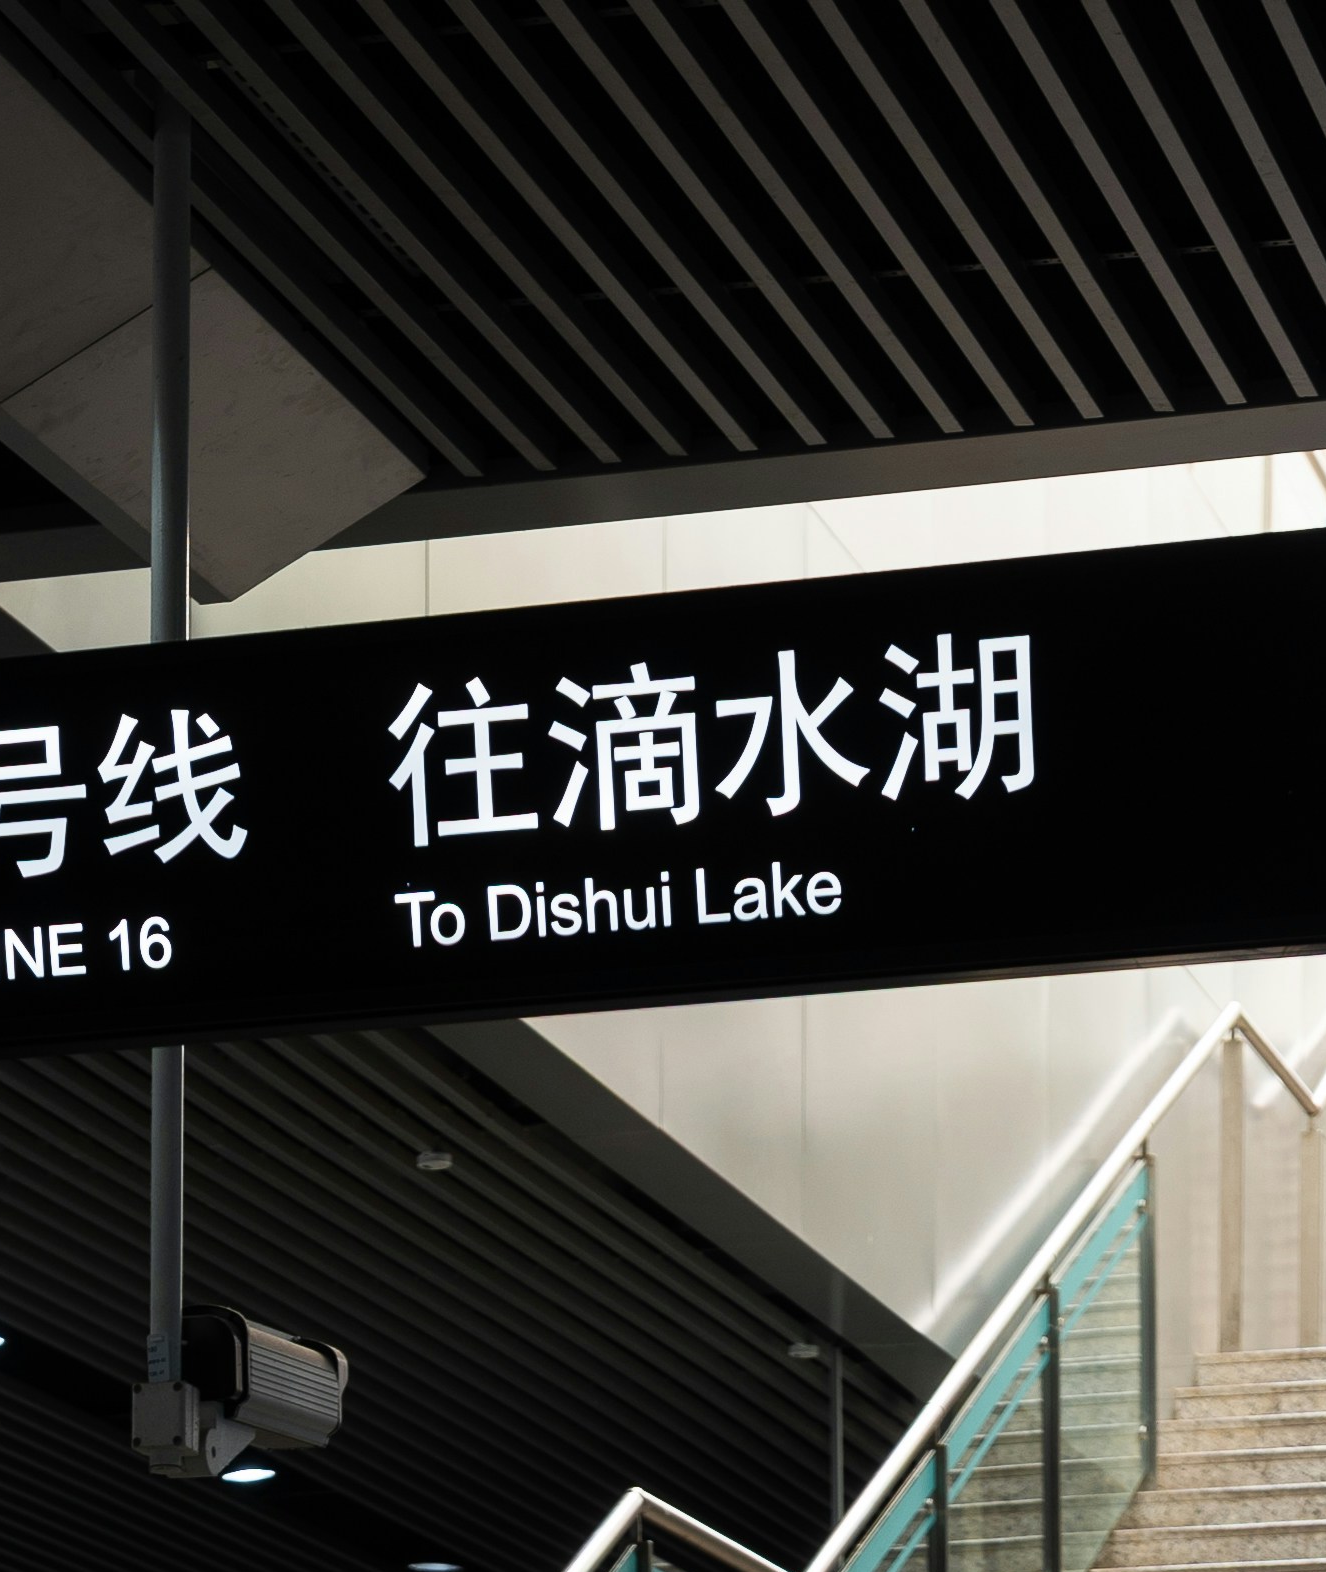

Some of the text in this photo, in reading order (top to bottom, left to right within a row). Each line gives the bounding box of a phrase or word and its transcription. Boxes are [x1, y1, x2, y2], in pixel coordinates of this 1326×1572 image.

[387, 633, 1036, 848] 往滴水湖
[108, 916, 174, 971] 16
[394, 861, 842, 948] To Dishui Lake
